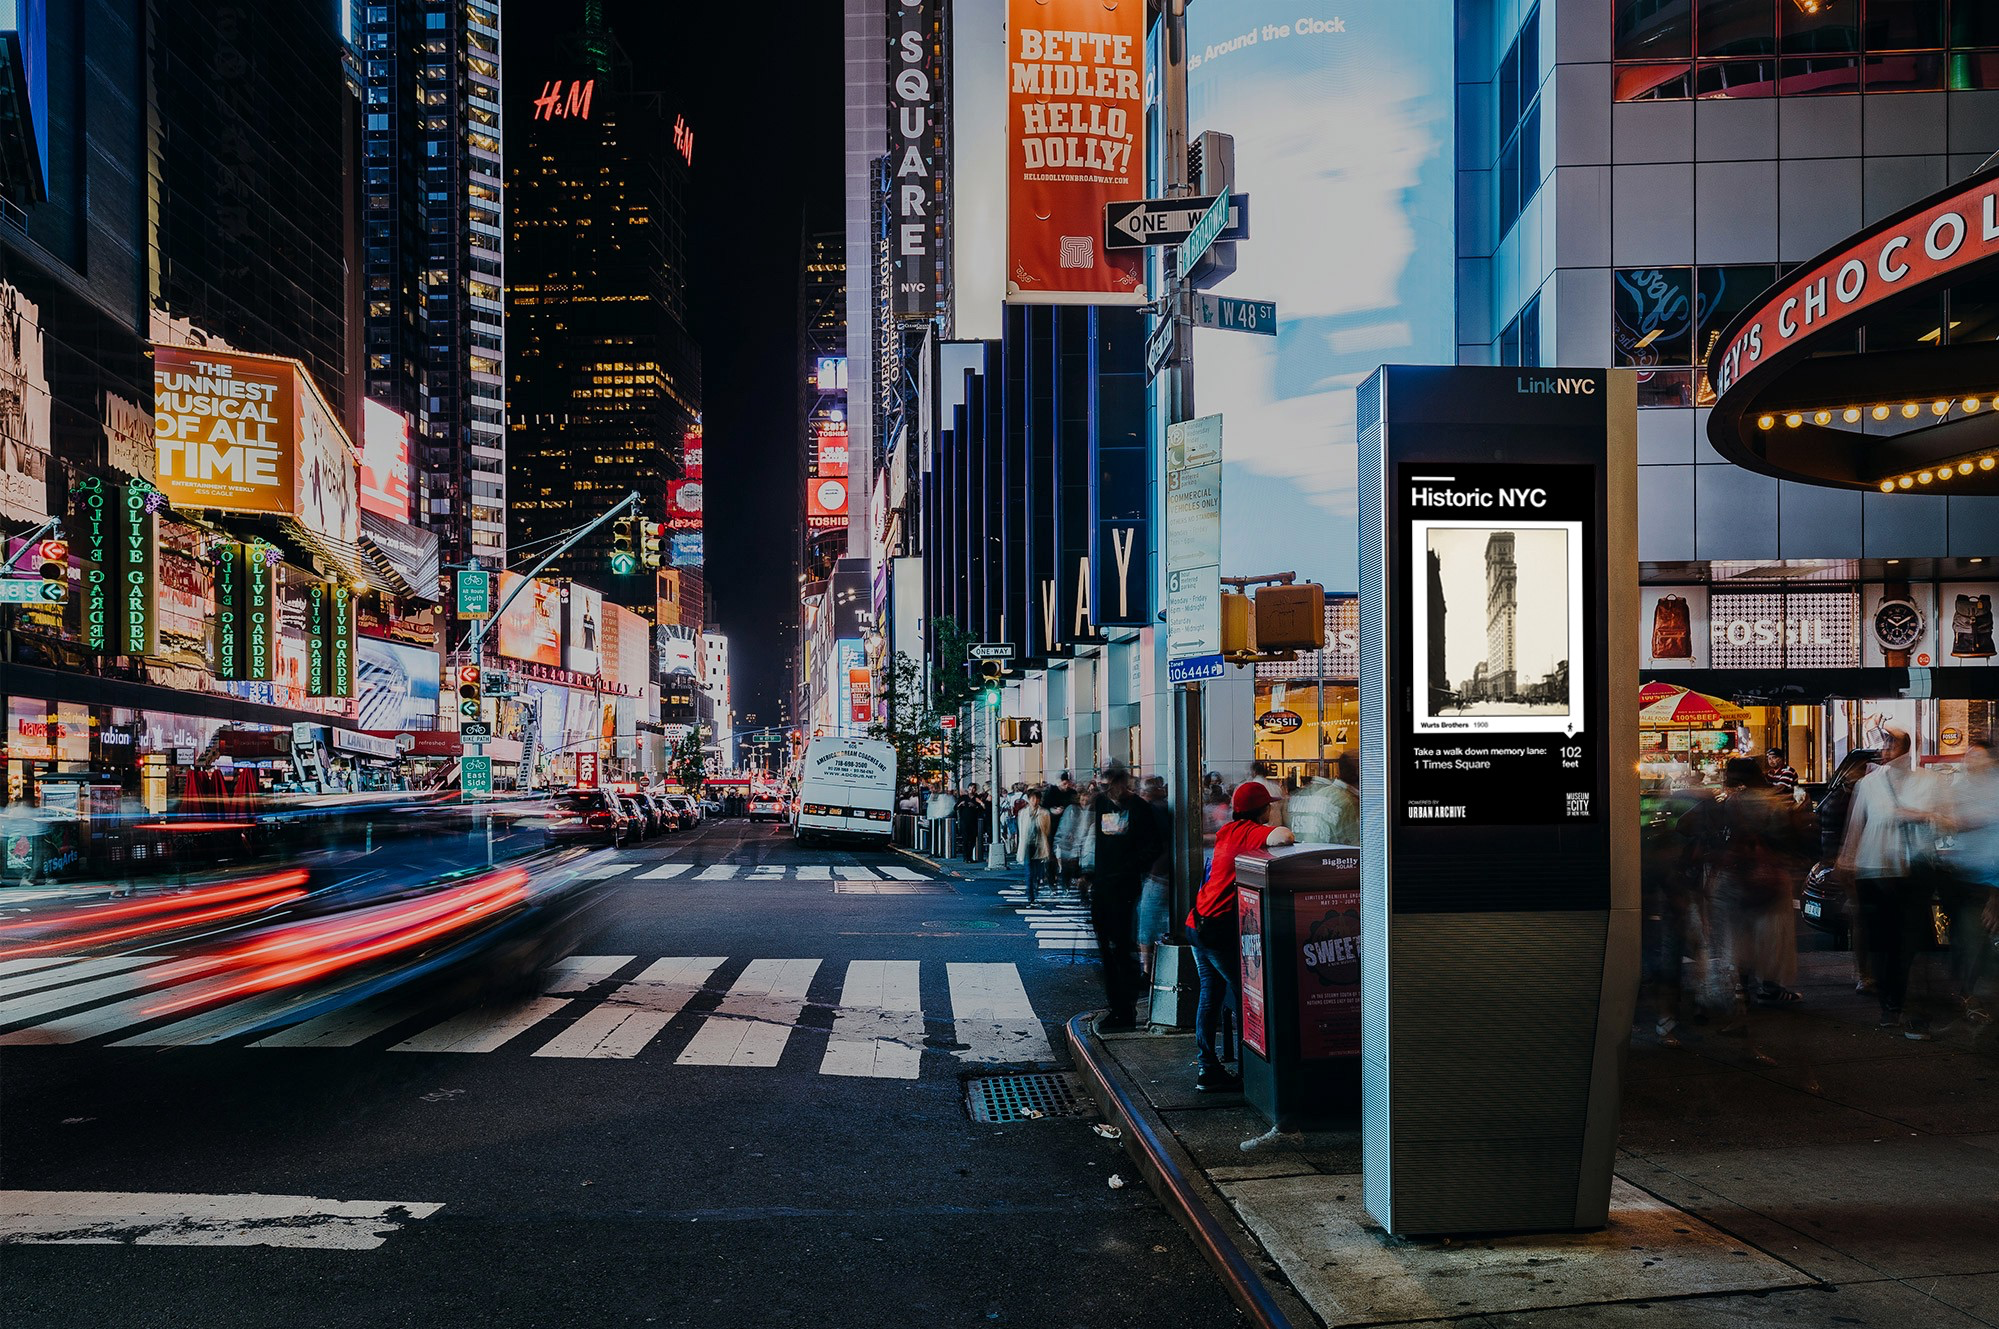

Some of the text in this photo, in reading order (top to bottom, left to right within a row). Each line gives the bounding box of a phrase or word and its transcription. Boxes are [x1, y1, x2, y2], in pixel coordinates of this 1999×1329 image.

[1020, 29, 1132, 66] BETTE
[1205, 28, 1258, 63] Around
[1262, 24, 1290, 41] the
[1295, 17, 1345, 35] Clock
[1012, 62, 1140, 100] MIDLER
[534, 80, 594, 121] H&M
[1022, 103, 1133, 145] HELLO,
[673, 113, 694, 167] H&M
[895, 30, 931, 257] SQUARE
[1022, 136, 1132, 174] DOLLY!
[1023, 173, 1129, 185] HELLODOLLYONBROADWAY.COM
[1129, 214, 1168, 233] ONE
[1191, 193, 1227, 262] BROADWAY
[1778, 193, 1999, 340] CHOCOL
[901, 282, 926, 293] NYC
[1223, 301, 1272, 329] W 48 ST
[880, 237, 890, 416] AMERICAN EAGLE
[154, 371, 278, 402] FUNNIEST
[1517, 376, 1596, 395] LinkNYC
[154, 391, 278, 424] MUSICAL
[155, 412, 278, 449] OF ALL
[171, 480, 255, 493] ENTERTAINMENT WEEKLY
[1169, 472, 1179, 489] 3
[1170, 488, 1212, 504] COMMERCIAL
[1201, 498, 1218, 509] ONLY
[1411, 487, 1547, 508] Historic NYC
[808, 517, 848, 526] TOSHIB
[127, 495, 145, 652] OLIVE GARDEN
[1169, 573, 1179, 592] 6
[251, 552, 266, 679] OLIVE GARDEN
[335, 588, 349, 696] OLIVE GARDEN
[1711, 619, 1832, 646] FOSSIL
[976, 647, 1009, 656] ONE WAY
[1170, 664, 1210, 681] 106444
[567, 671, 629, 695] BRODWAY
[1263, 717, 1298, 726] FOSSIL
[101, 726, 129, 745] rabian
[418, 739, 446, 747] refreshed
[816, 751, 841, 766] AMERICA
[858, 751, 880, 765] COACHES
[1413, 747, 1434, 755] Take
[1443, 747, 1463, 755] walk
[1464, 747, 1489, 755] down
[1490, 748, 1525, 756] memory
[1526, 747, 1547, 755] lane:
[1559, 746, 1582, 758] 102
[581, 754, 595, 781] tkts
[1414, 760, 1491, 770] 1 Times Square
[1562, 760, 1579, 768] feet
[1566, 792, 1590, 800] MUSEUM
[1571, 800, 1590, 811] CITY
[1408, 805, 1467, 819] URBAN ARCHIVE
[1321, 857, 1359, 867] BigBelly
